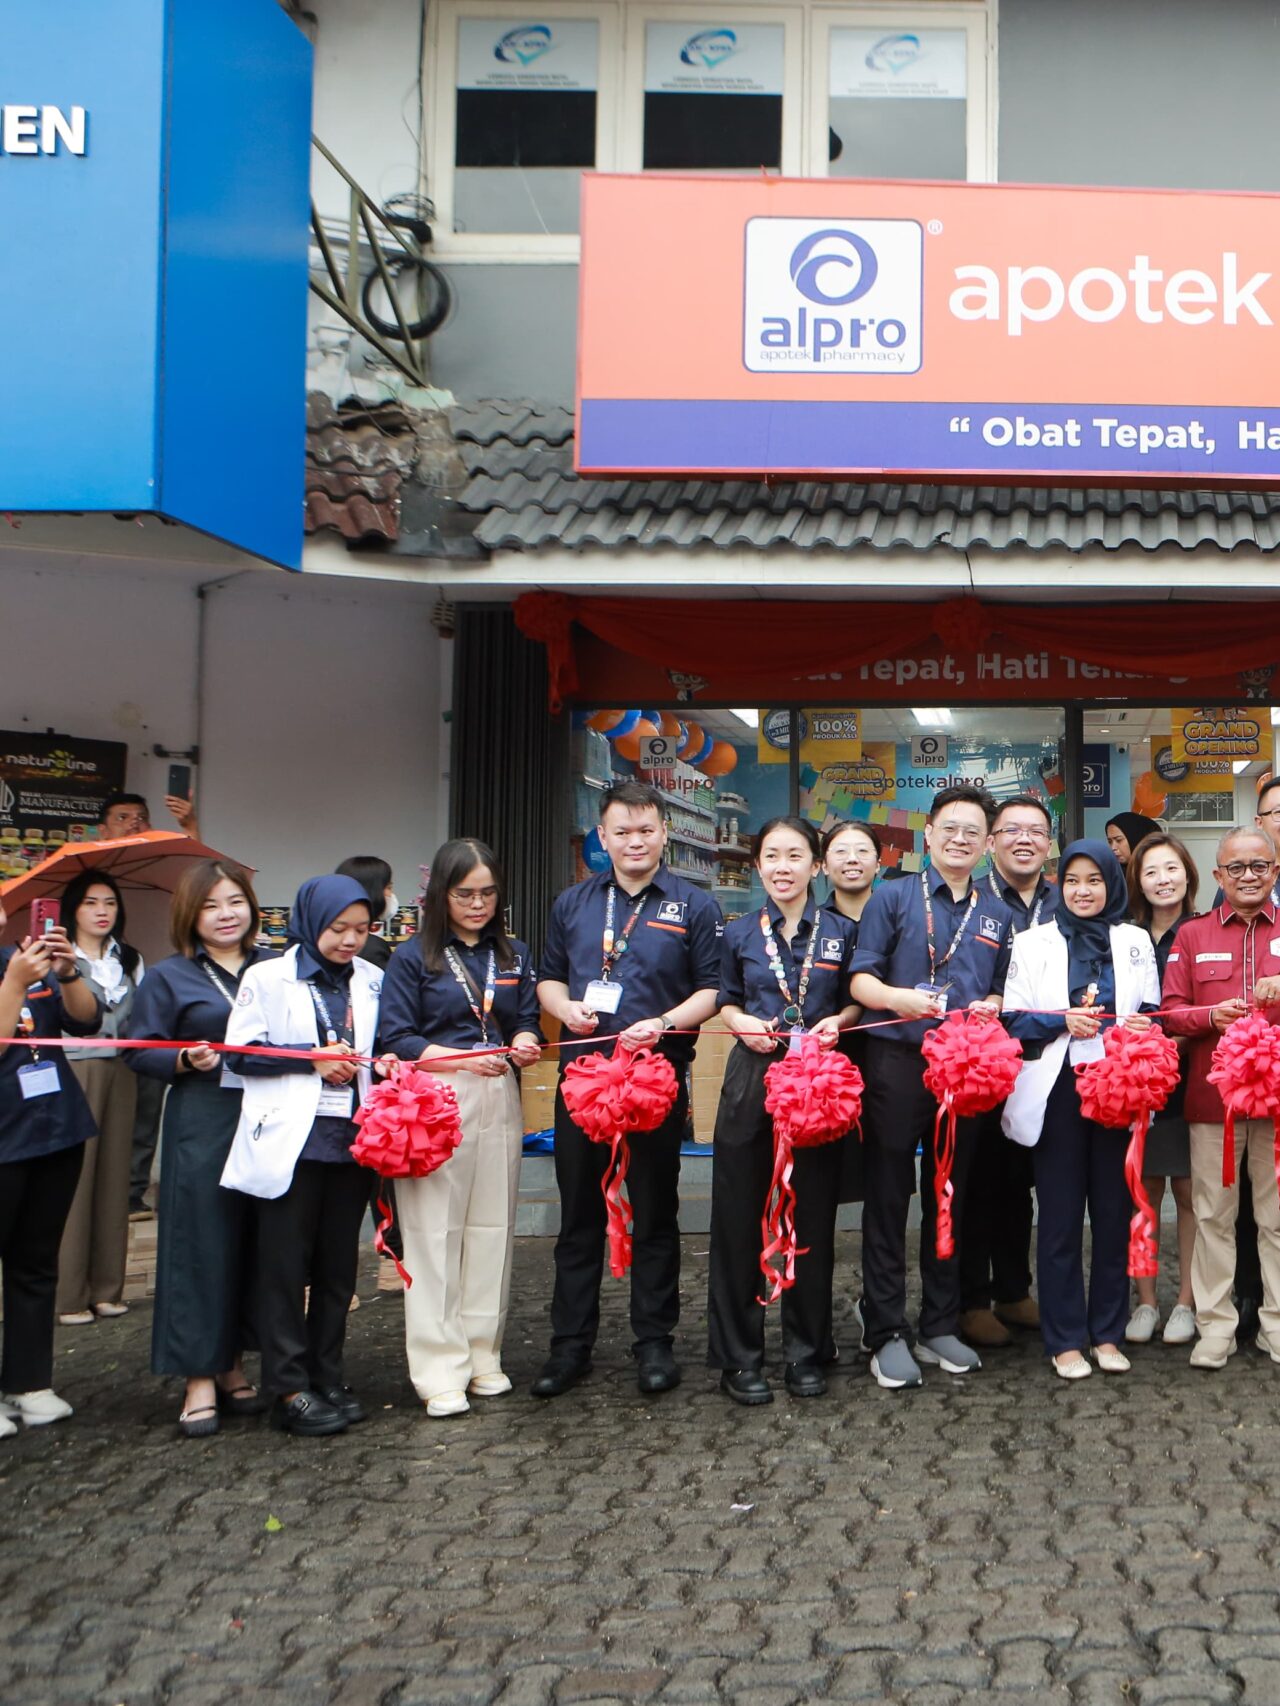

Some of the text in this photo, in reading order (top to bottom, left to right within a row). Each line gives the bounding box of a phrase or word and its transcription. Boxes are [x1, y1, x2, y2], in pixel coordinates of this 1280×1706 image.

[949, 252, 1273, 336] apotek
[760, 307, 906, 362] alpro
[760, 350, 905, 362] apotek pharmacy
[982, 416, 1081, 448] Obat
[1093, 419, 1215, 454] Tepat,
[977, 653, 1050, 680] Hati
[813, 720, 857, 732] 100%
[1184, 721, 1259, 739] GRAND
[1185, 740, 1259, 755] OPENING
[6, 754, 97, 772] natureline
[643, 754, 673, 766] alpro
[914, 754, 944, 766] alpro
[20, 797, 104, 811] MANUFACTUR
